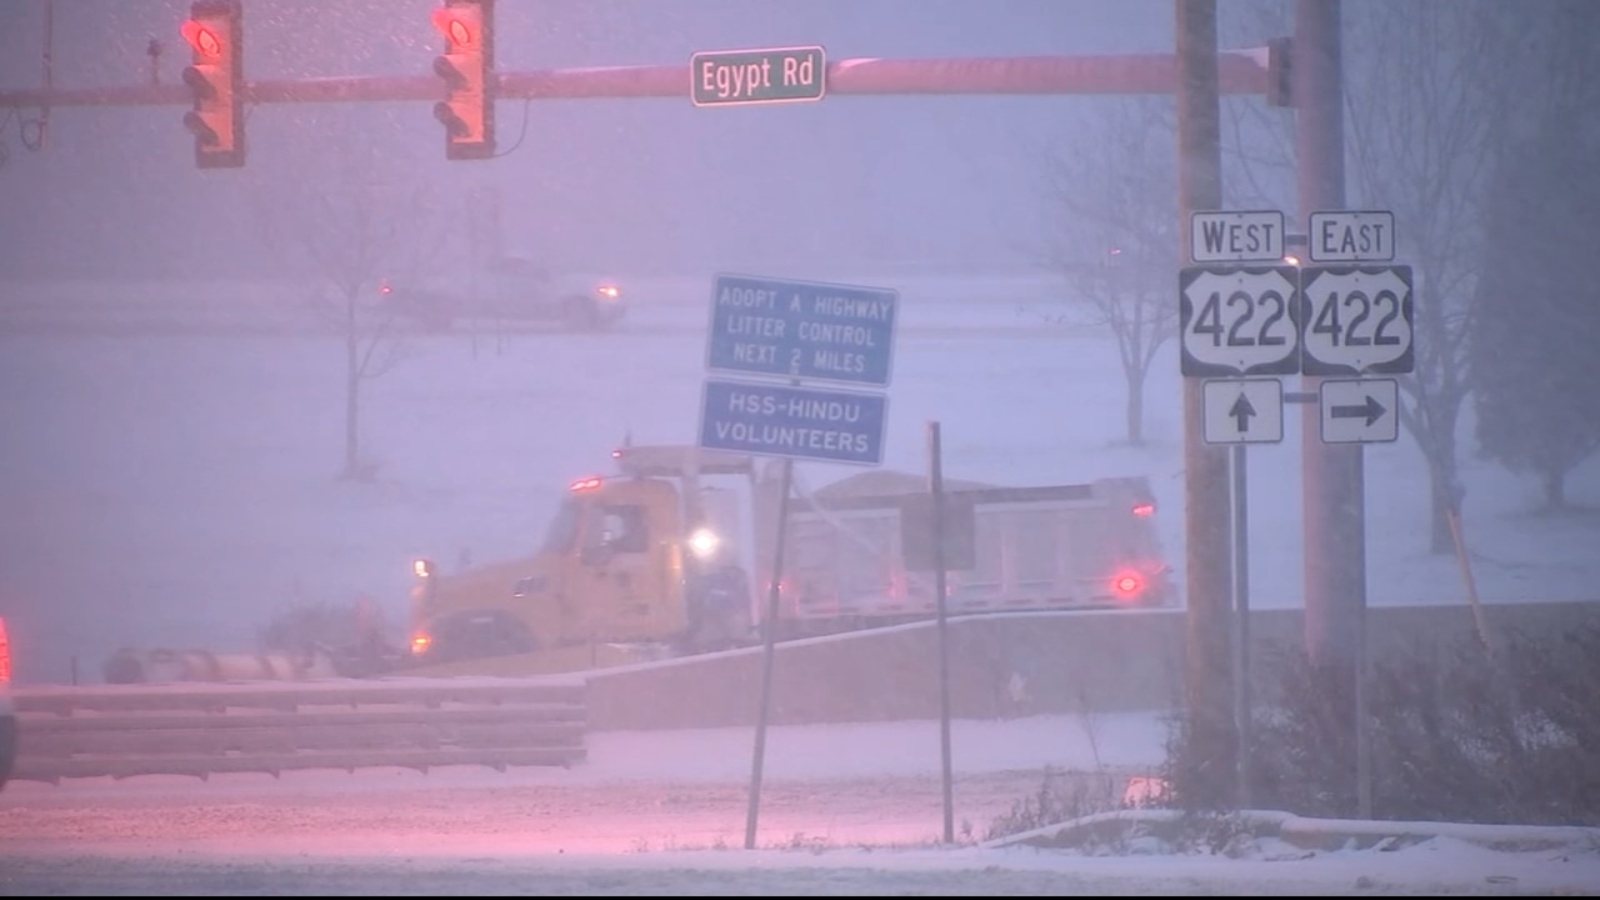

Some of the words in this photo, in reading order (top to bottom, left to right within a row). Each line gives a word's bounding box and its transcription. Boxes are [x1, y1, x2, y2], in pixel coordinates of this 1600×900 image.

[703, 58, 771, 98] Egypt
[783, 53, 813, 86] Rd
[1202, 220, 1275, 254] WEST
[1322, 220, 1384, 254] EAST
[719, 286, 777, 309] ADOPT
[789, 293, 801, 312] A
[814, 296, 892, 321] HIGHWAY
[1192, 289, 1287, 347] 422
[1312, 288, 1401, 347] 422
[727, 315, 786, 338] LITTER
[798, 321, 876, 347] CONTROL
[733, 343, 777, 364] NEXT
[790, 348, 801, 367] 2
[813, 350, 866, 373] MILES
[728, 392, 861, 423] HSS-HINDU
[715, 420, 869, 453] VOLUNTEERS
